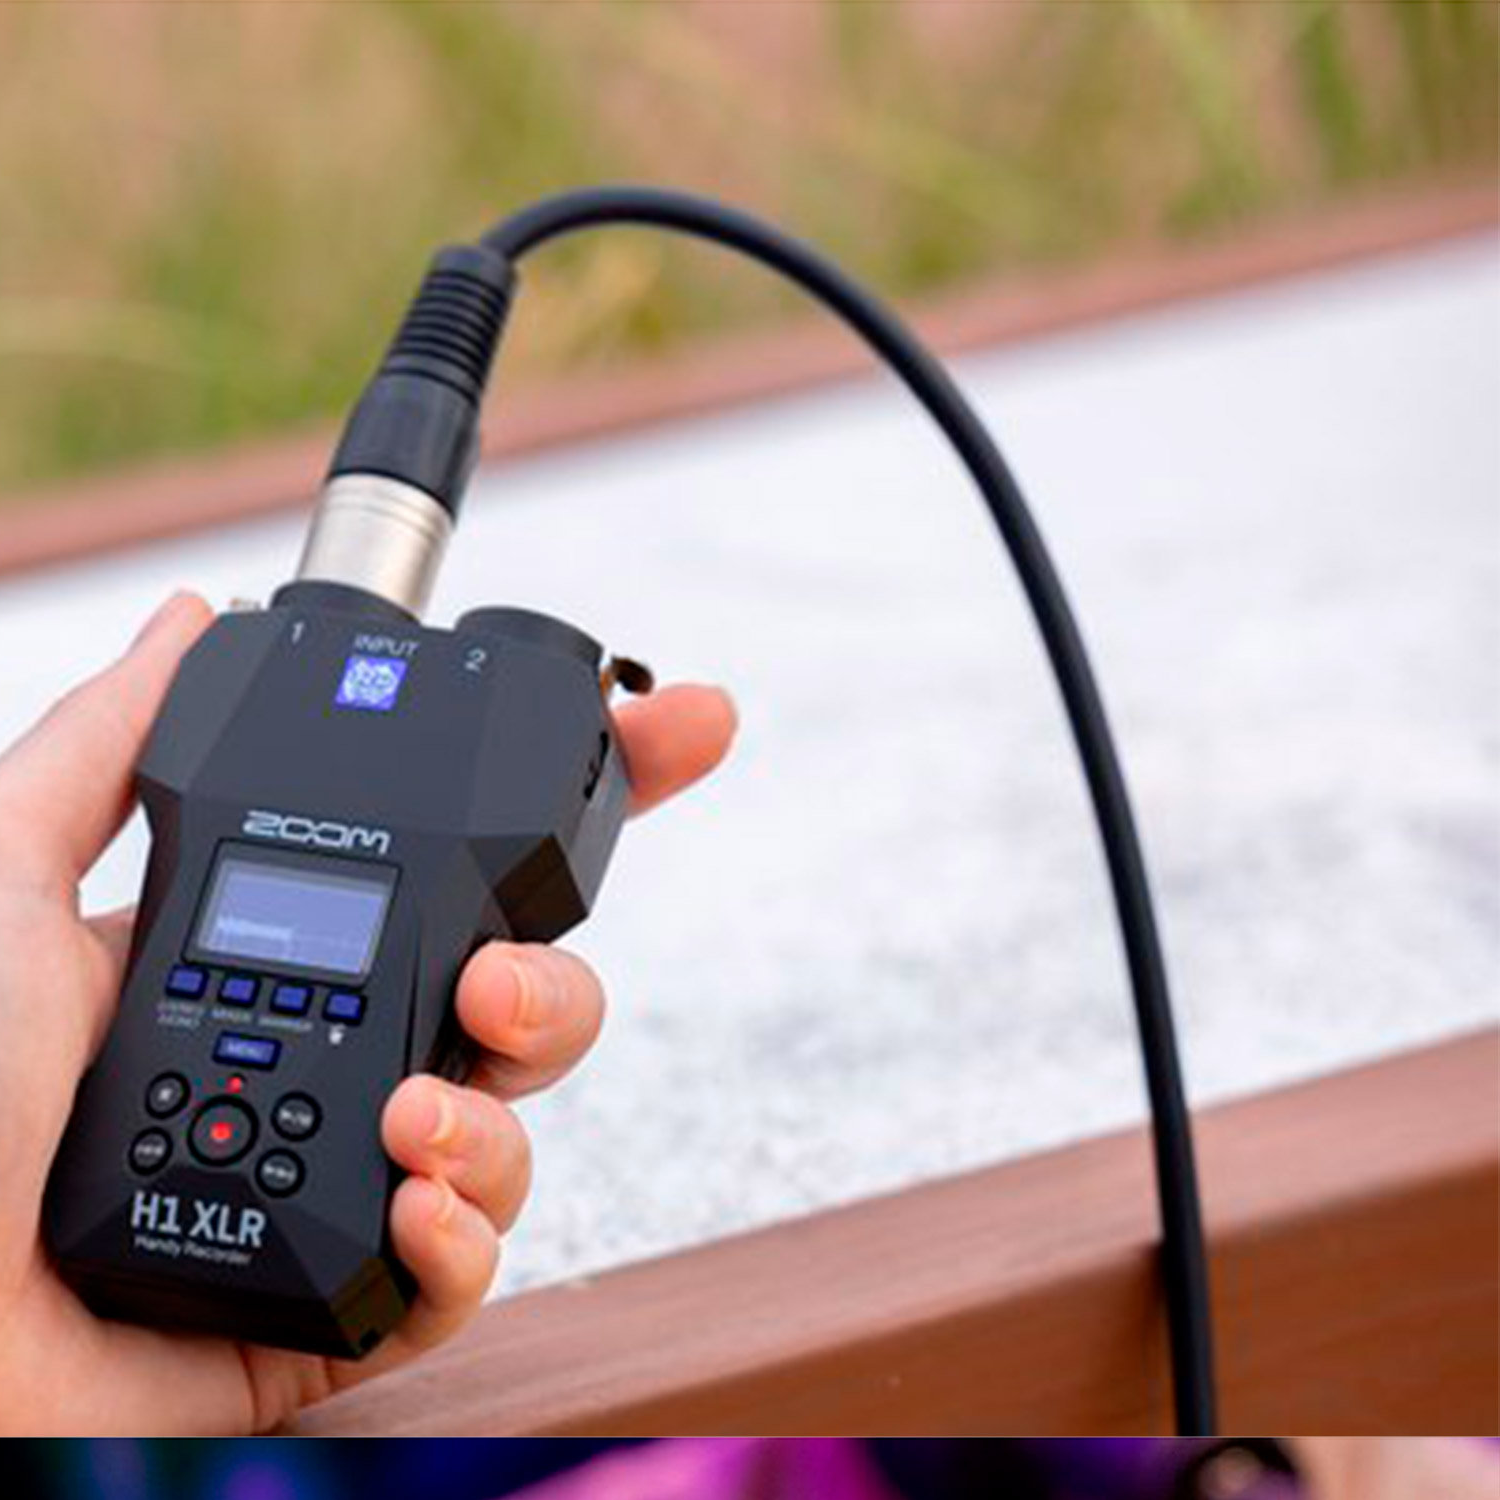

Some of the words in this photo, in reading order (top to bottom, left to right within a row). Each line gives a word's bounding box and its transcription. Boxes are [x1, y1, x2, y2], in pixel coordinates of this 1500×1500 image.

[292, 622, 304, 644] 1
[355, 633, 420, 657] INPUT
[464, 648, 487, 673] 2
[242, 810, 391, 855] ZOOM
[130, 1190, 181, 1234] H1
[188, 1200, 267, 1248] XLR
[134, 1235, 181, 1258] Handy
[183, 1239, 251, 1266] Recorder
